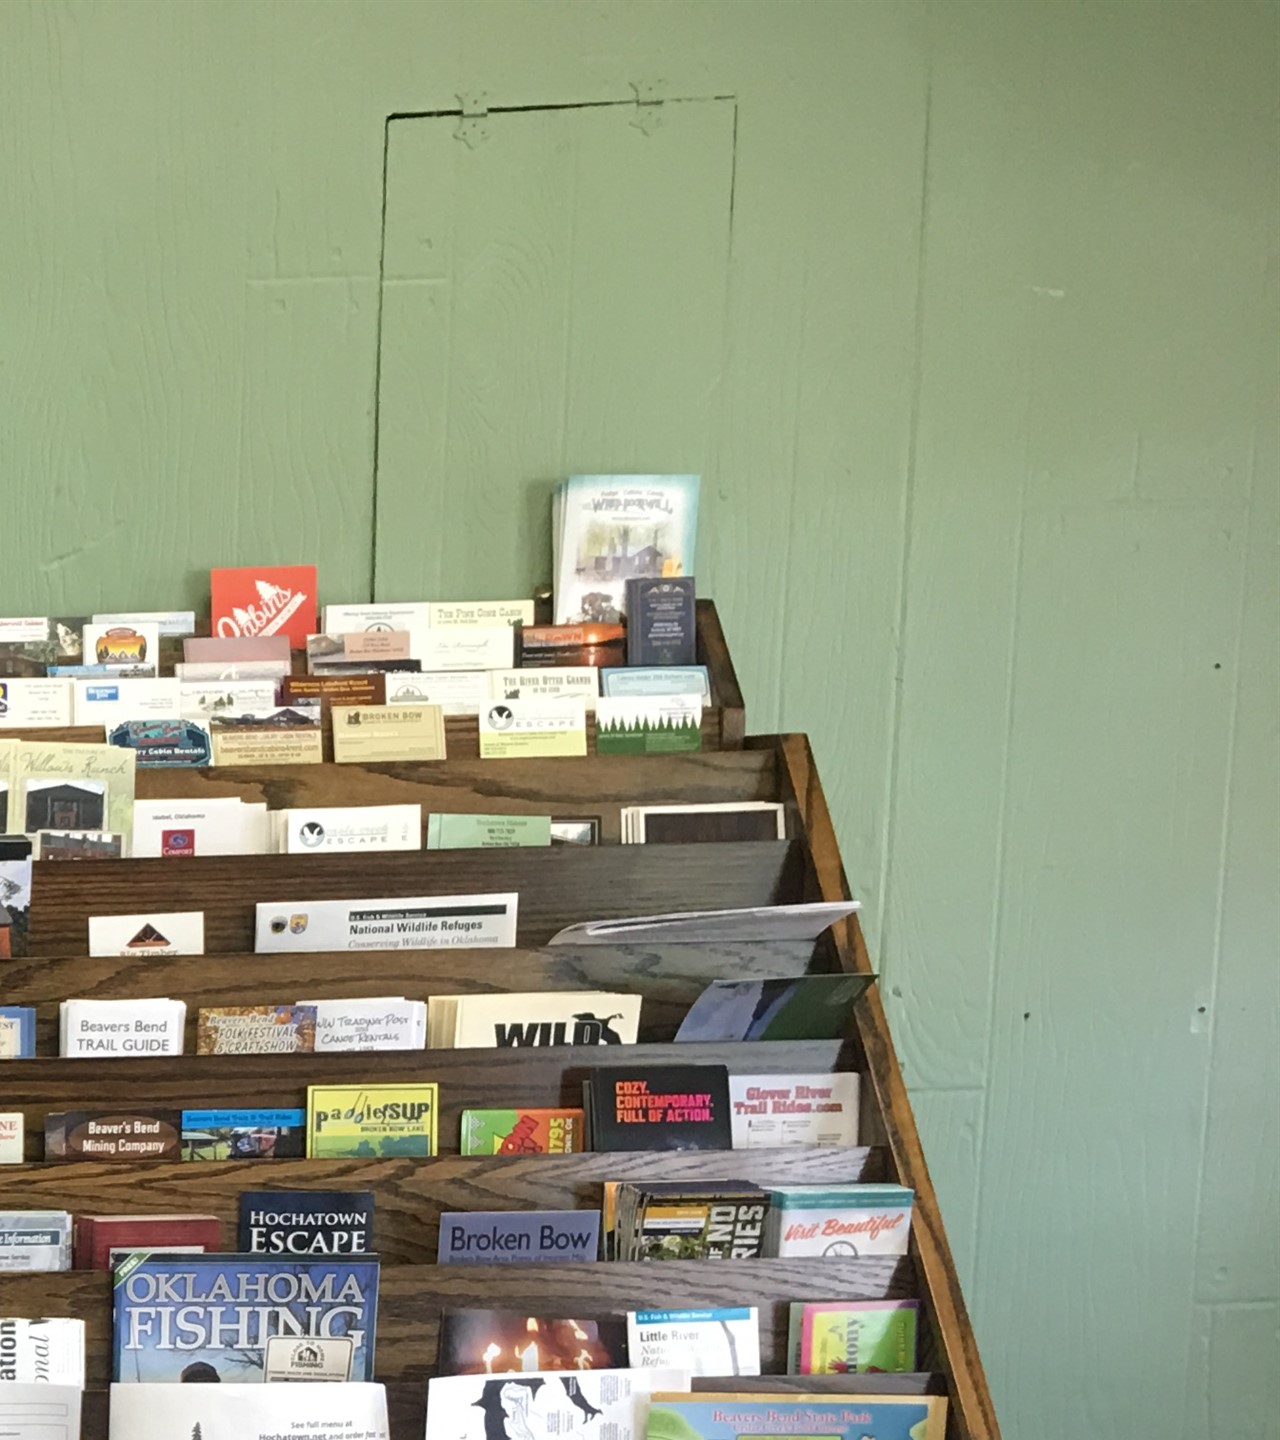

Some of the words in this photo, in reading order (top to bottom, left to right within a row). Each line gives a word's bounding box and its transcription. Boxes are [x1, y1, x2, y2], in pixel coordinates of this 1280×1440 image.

[402, 712, 422, 720] BOW
[327, 836, 388, 844] ESCAPE
[350, 923, 393, 935] National
[397, 921, 437, 933] Wildlife
[441, 919, 483, 931] Refuges
[440, 937, 449, 945] in
[80, 1020, 128, 1033] Beavers
[134, 1020, 167, 1033] Bend
[77, 1038, 120, 1051] TRAIL
[122, 1038, 170, 1051] GUIDE
[616, 1082, 649, 1094] COZY.
[616, 1094, 713, 1107] CONTEMPORARY.
[617, 1109, 645, 1122] FULL
[648, 1109, 663, 1122] OF
[667, 1108, 713, 1121] ACTION.
[88, 1121, 131, 1134] Beaver's
[135, 1121, 160, 1133] Bend
[82, 1140, 115, 1154] Mining
[118, 1139, 165, 1153] Company
[250, 1211, 367, 1226] HOCHATOWN
[785, 1222, 819, 1240] Visit
[824, 1213, 902, 1239] Beautiful
[6, 1232, 52, 1245] Information
[250, 1228, 366, 1253] ESCAPE
[451, 1227, 529, 1251] Broken
[540, 1226, 591, 1249] Bow
[126, 1273, 365, 1303] OKLAHOMA
[640, 1331, 668, 1342] Little
[671, 1331, 699, 1341] River
[712, 1411, 762, 1422] Beavers
[767, 1411, 799, 1422] Bend
